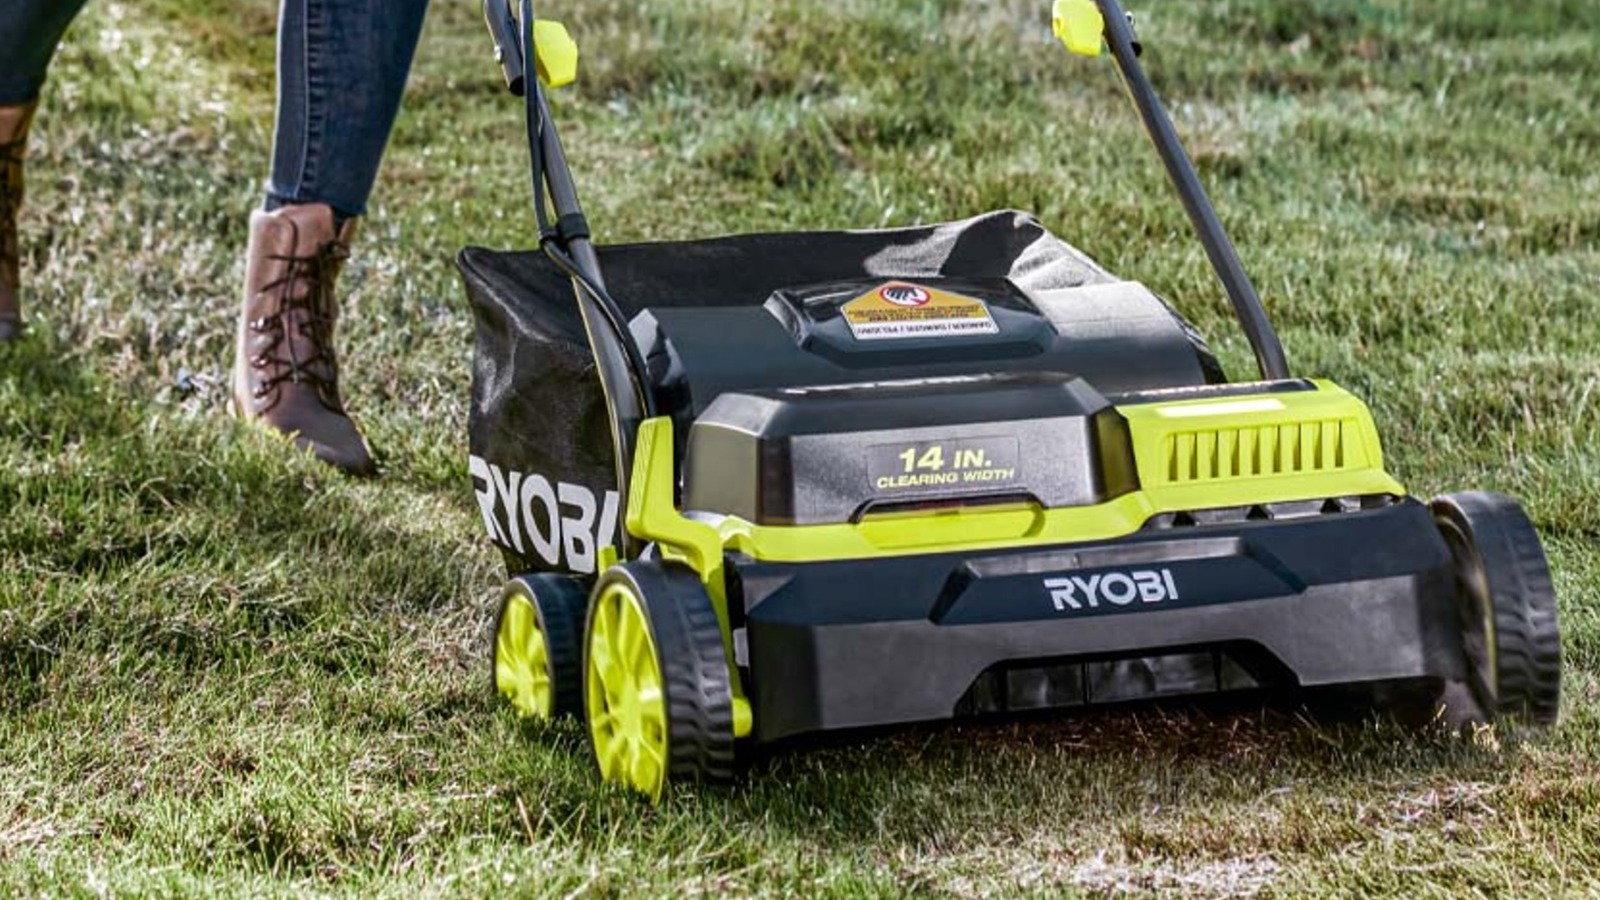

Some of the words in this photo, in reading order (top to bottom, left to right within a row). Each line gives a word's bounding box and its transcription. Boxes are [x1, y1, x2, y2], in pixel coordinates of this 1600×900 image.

[899, 446, 944, 472] 14
[954, 449, 992, 469] IN.
[877, 472, 958, 488] CLEARING
[963, 468, 1015, 481] WIDTH
[469, 454, 620, 574] RYOBI
[1043, 568, 1179, 611] RYOBI
